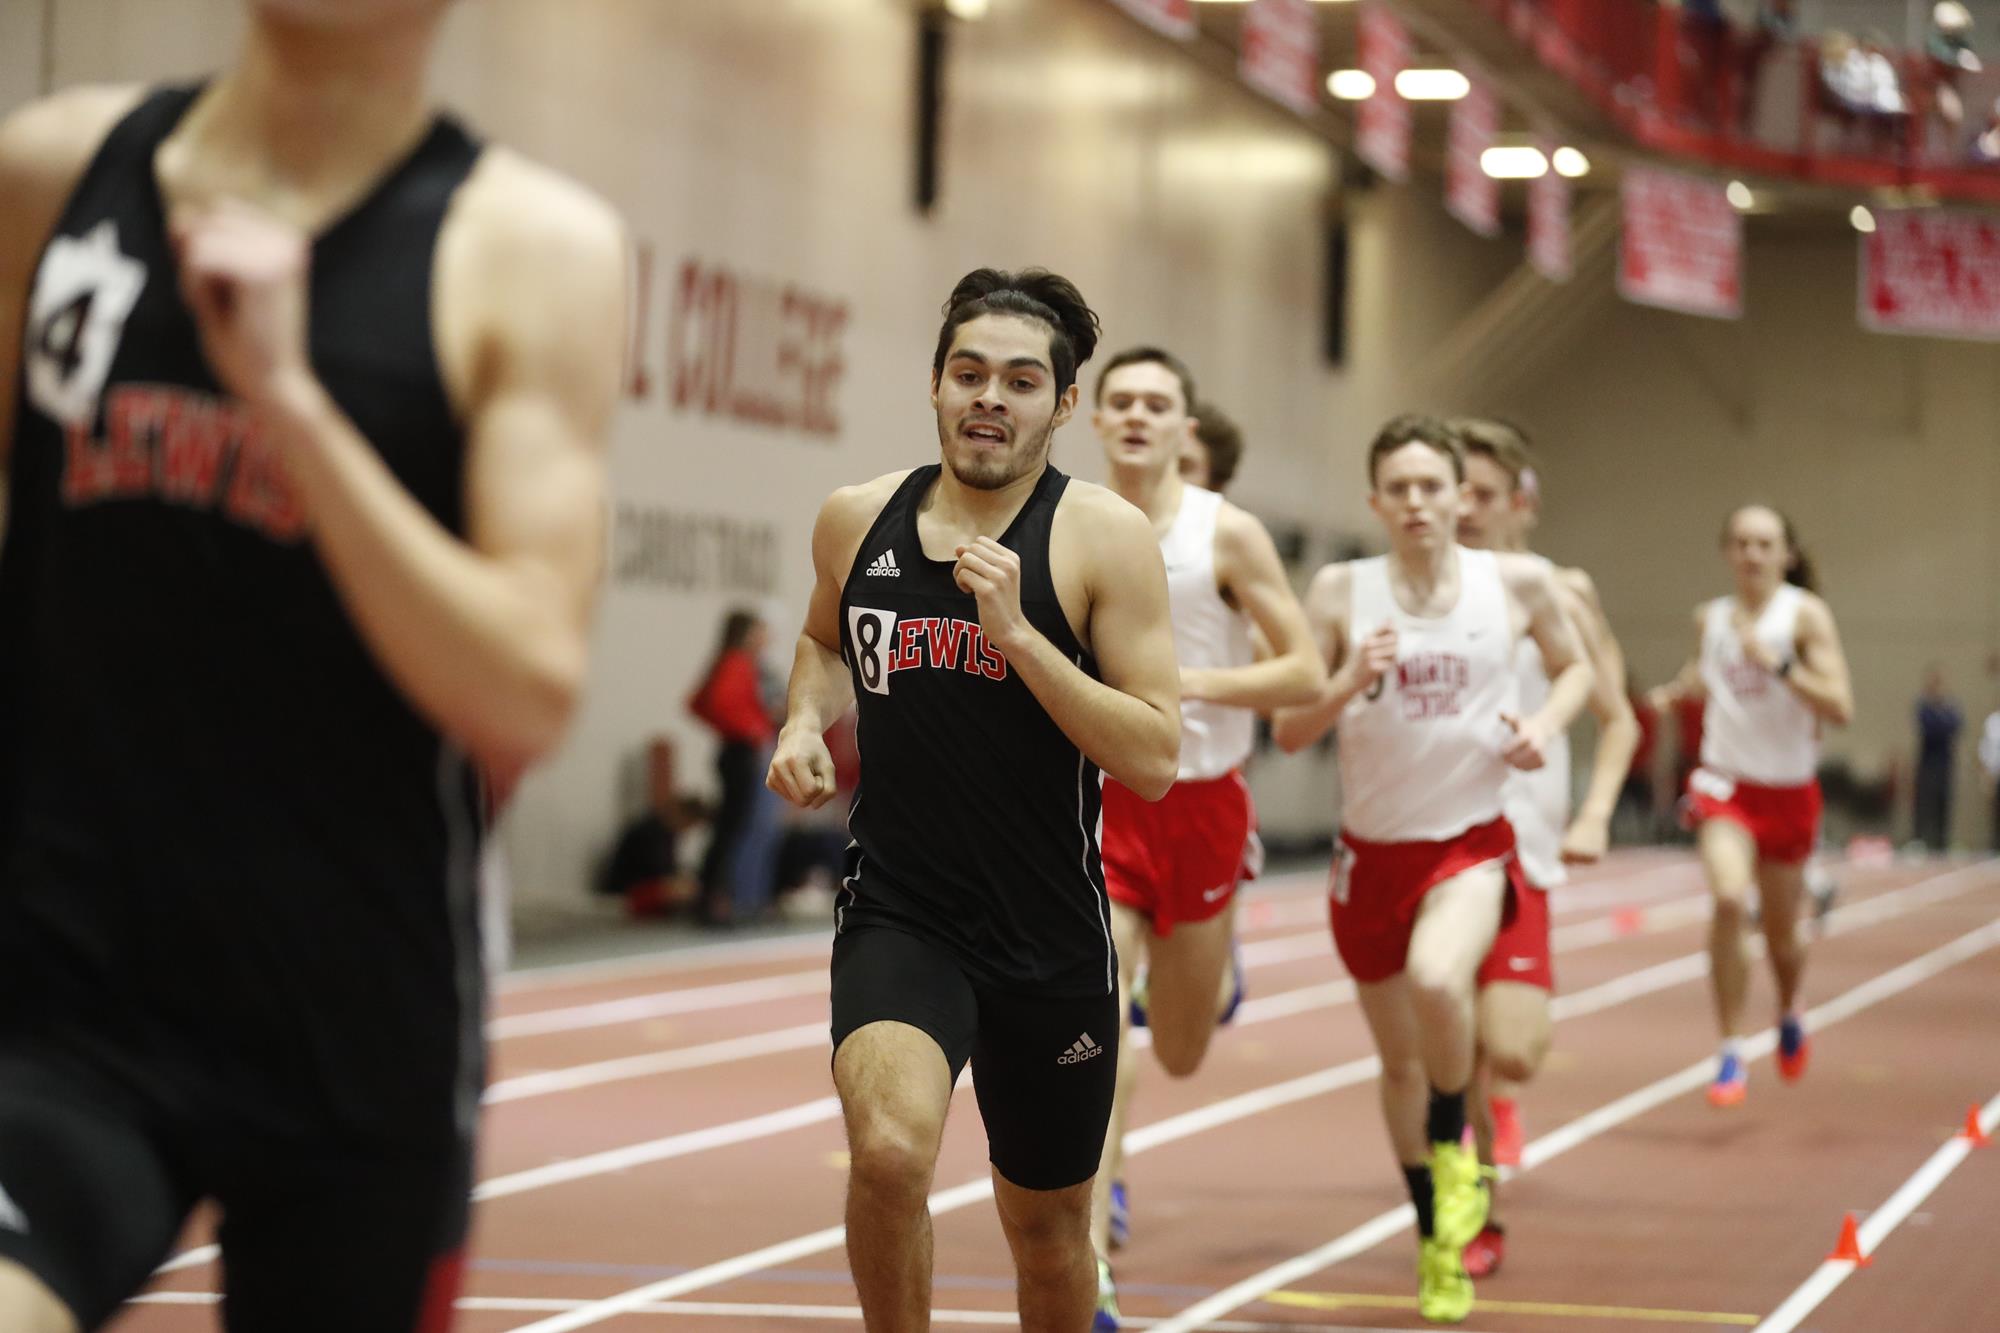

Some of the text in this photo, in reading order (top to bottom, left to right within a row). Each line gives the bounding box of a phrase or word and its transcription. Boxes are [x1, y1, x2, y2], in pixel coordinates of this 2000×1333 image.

[866, 567, 900, 577] adidas
[857, 613, 882, 688] 8
[1057, 1046, 1103, 1064] adidas
